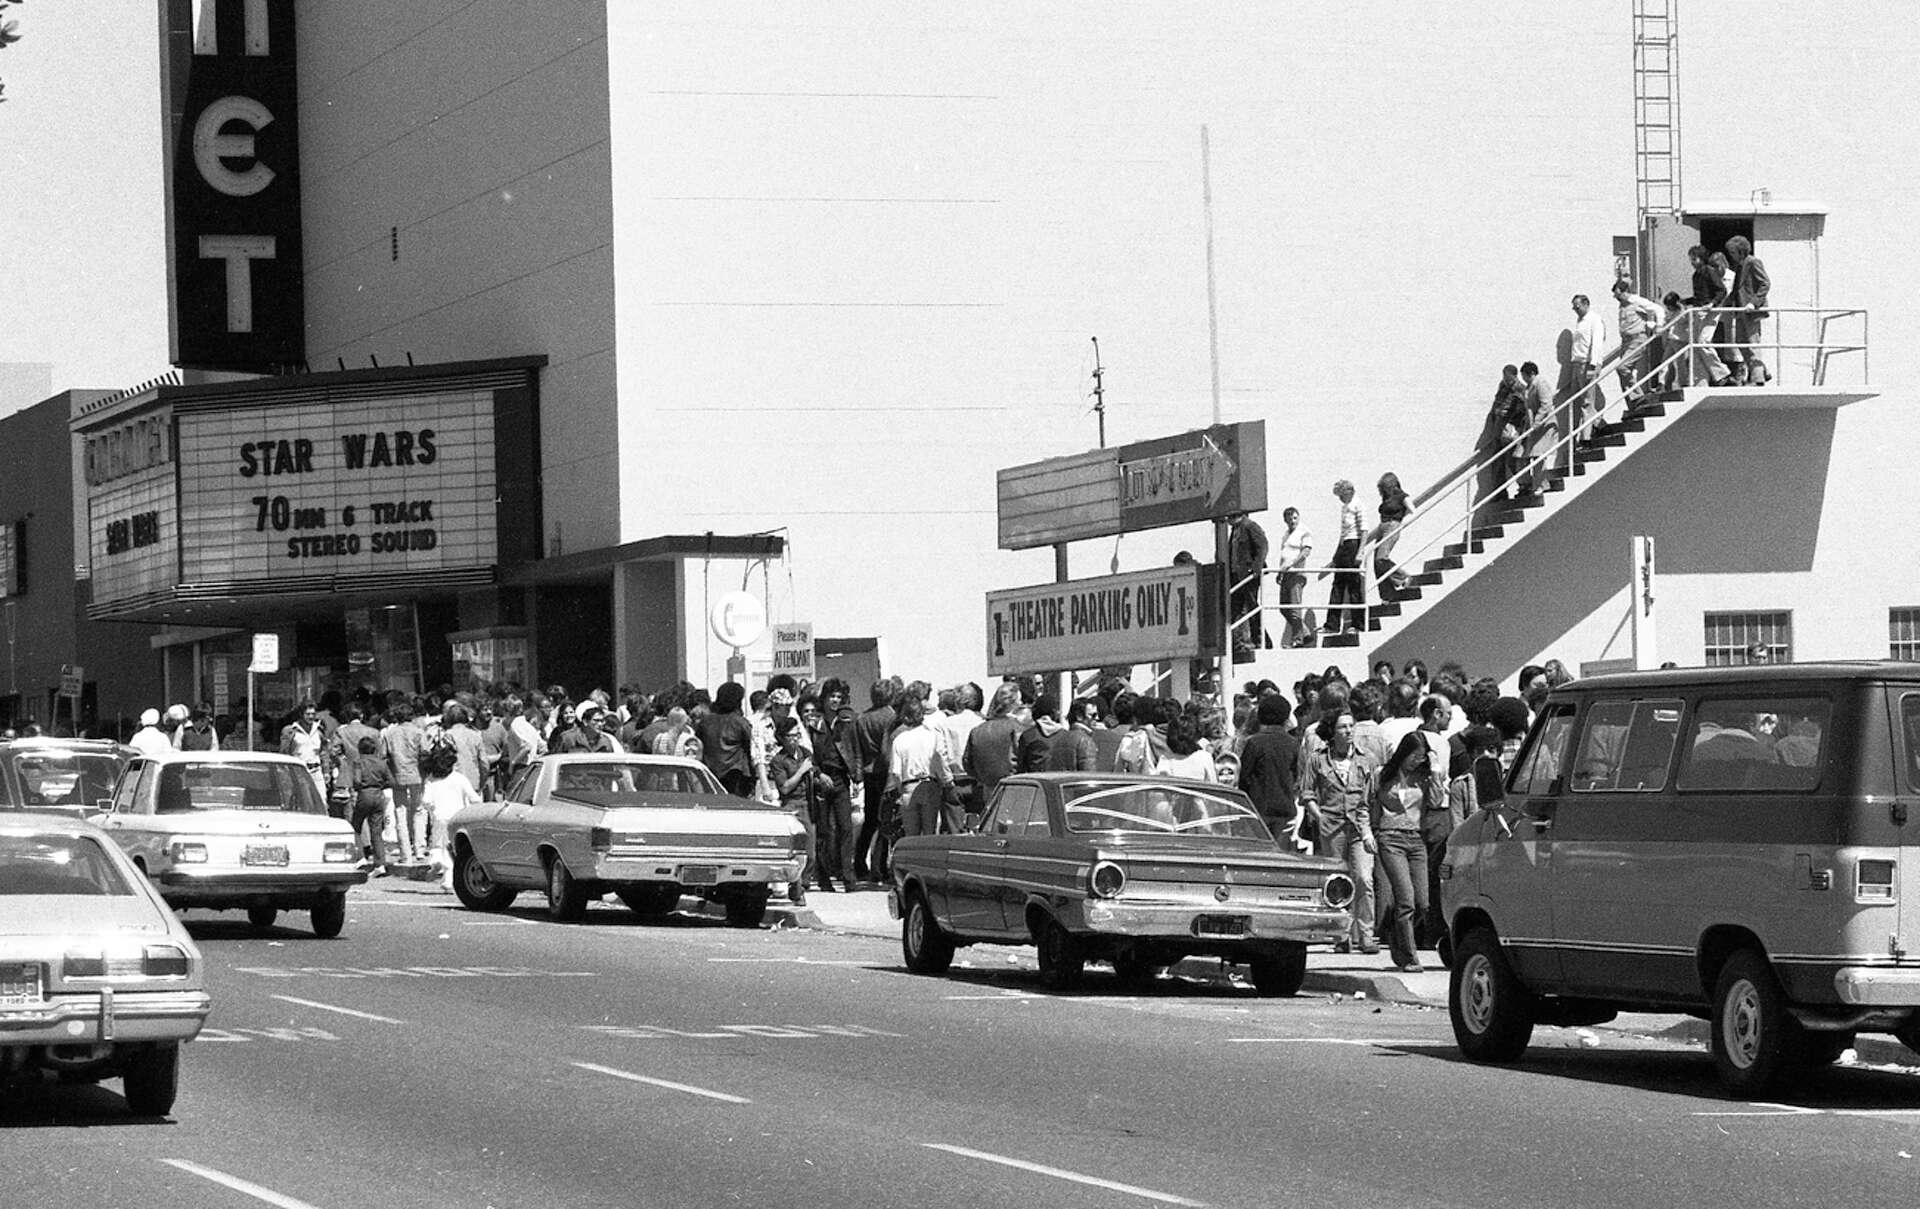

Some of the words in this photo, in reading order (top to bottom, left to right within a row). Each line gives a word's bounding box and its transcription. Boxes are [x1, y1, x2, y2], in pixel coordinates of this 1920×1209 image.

[239, 438, 313, 478] STAR
[342, 429, 437, 470] WARS
[342, 505, 355, 527] 6
[370, 500, 434, 525] TRACK
[287, 533, 361, 559] STEREO
[371, 528, 437, 553] SOUND
[1010, 596, 1064, 642] THEATRE
[1071, 586, 1131, 635] PARKING
[1137, 582, 1171, 629] ONLY
[775, 649, 811, 668] ATTENDANT
